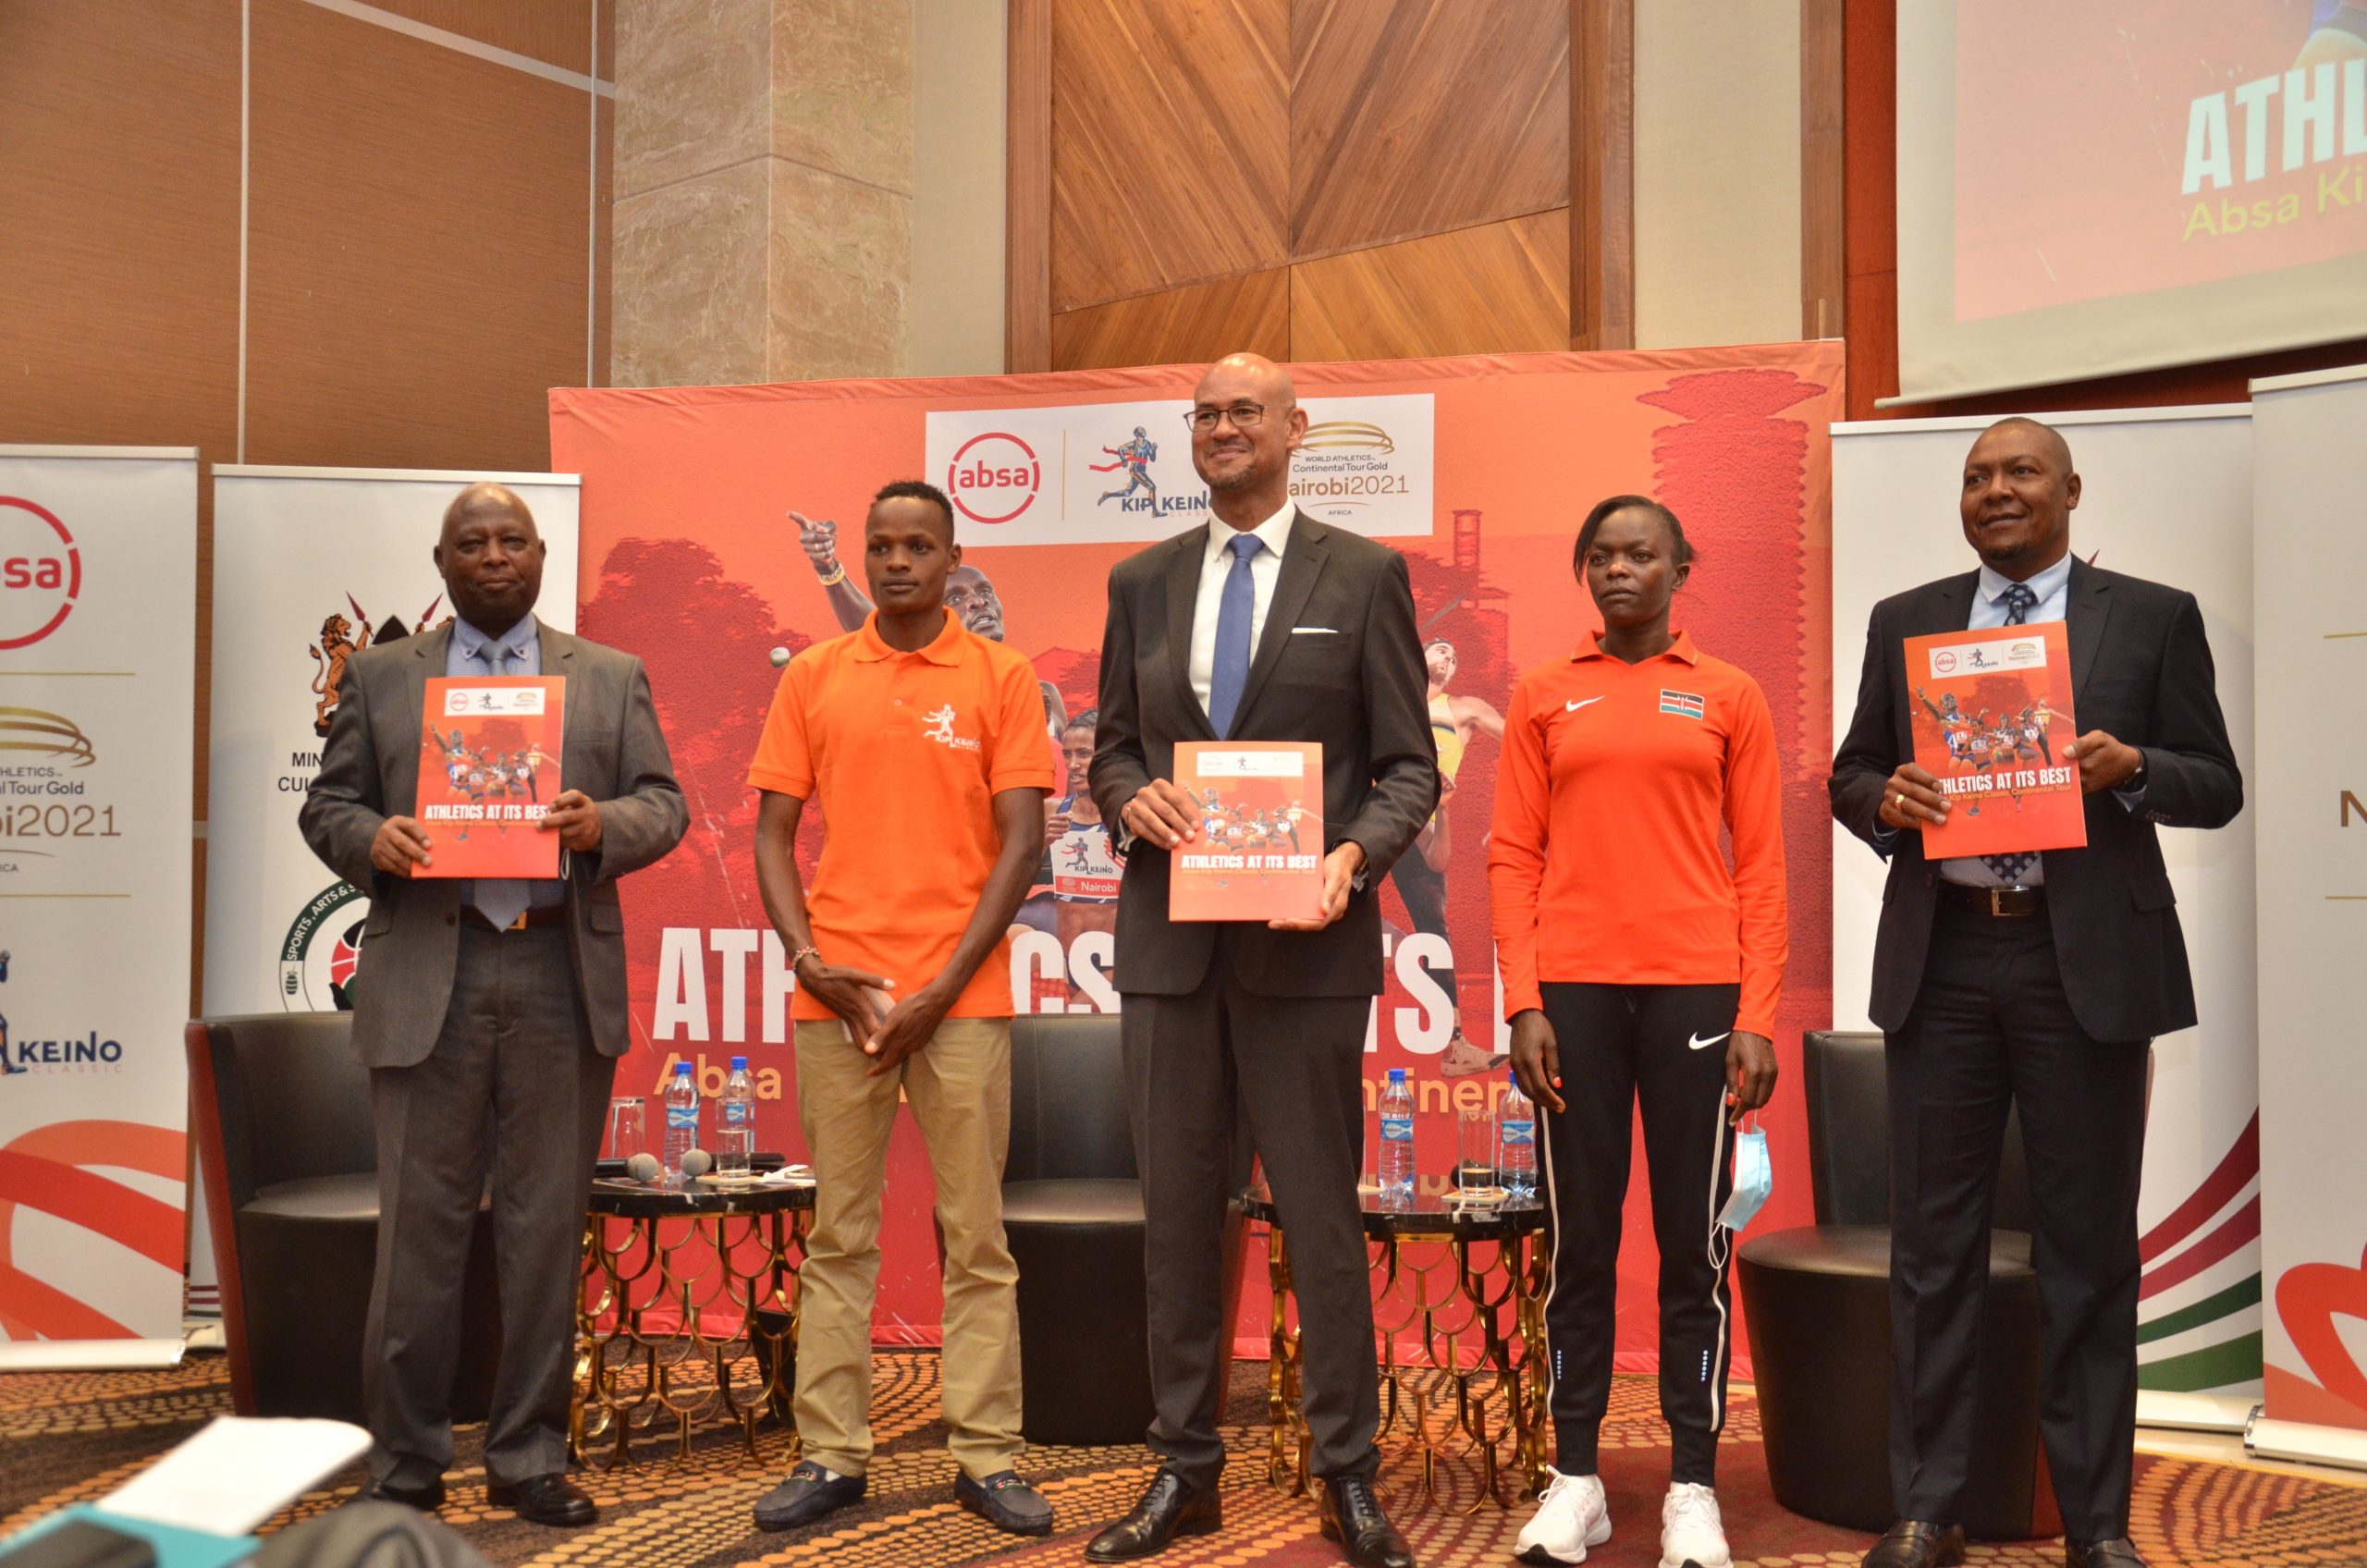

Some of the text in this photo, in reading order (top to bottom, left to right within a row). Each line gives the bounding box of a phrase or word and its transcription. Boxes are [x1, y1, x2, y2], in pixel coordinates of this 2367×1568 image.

[2182, 193, 2300, 241] Absa
[959, 460, 1029, 488] absa
[1293, 462, 1388, 472] Continental Tour Gold
[1289, 475, 1409, 496] airobi2021
[1122, 497, 1153, 512] KIP
[4, 557, 61, 589] sa
[292, 753, 322, 766] MIN
[0, 767, 55, 777] HLETICS
[278, 777, 309, 791] CUL
[1940, 766, 2071, 794] HLETICS AT ITS BEST
[7, 781, 44, 794] Tour
[46, 781, 84, 794] Gold
[2011, 786, 2054, 796] Continental
[424, 805, 548, 819] ATHLETICS AT ITS BES
[0, 804, 121, 837] i2021
[1181, 855, 1317, 869] ATHLETICS AT ITS BEST
[1090, 865, 1113, 874] KEINO
[1081, 881, 1117, 892] Nairobi
[311, 890, 339, 916] ARTS
[338, 886, 349, 897] &
[18, 1031, 122, 1062] KEINO
[32, 1064, 122, 1073] CLASSIC
